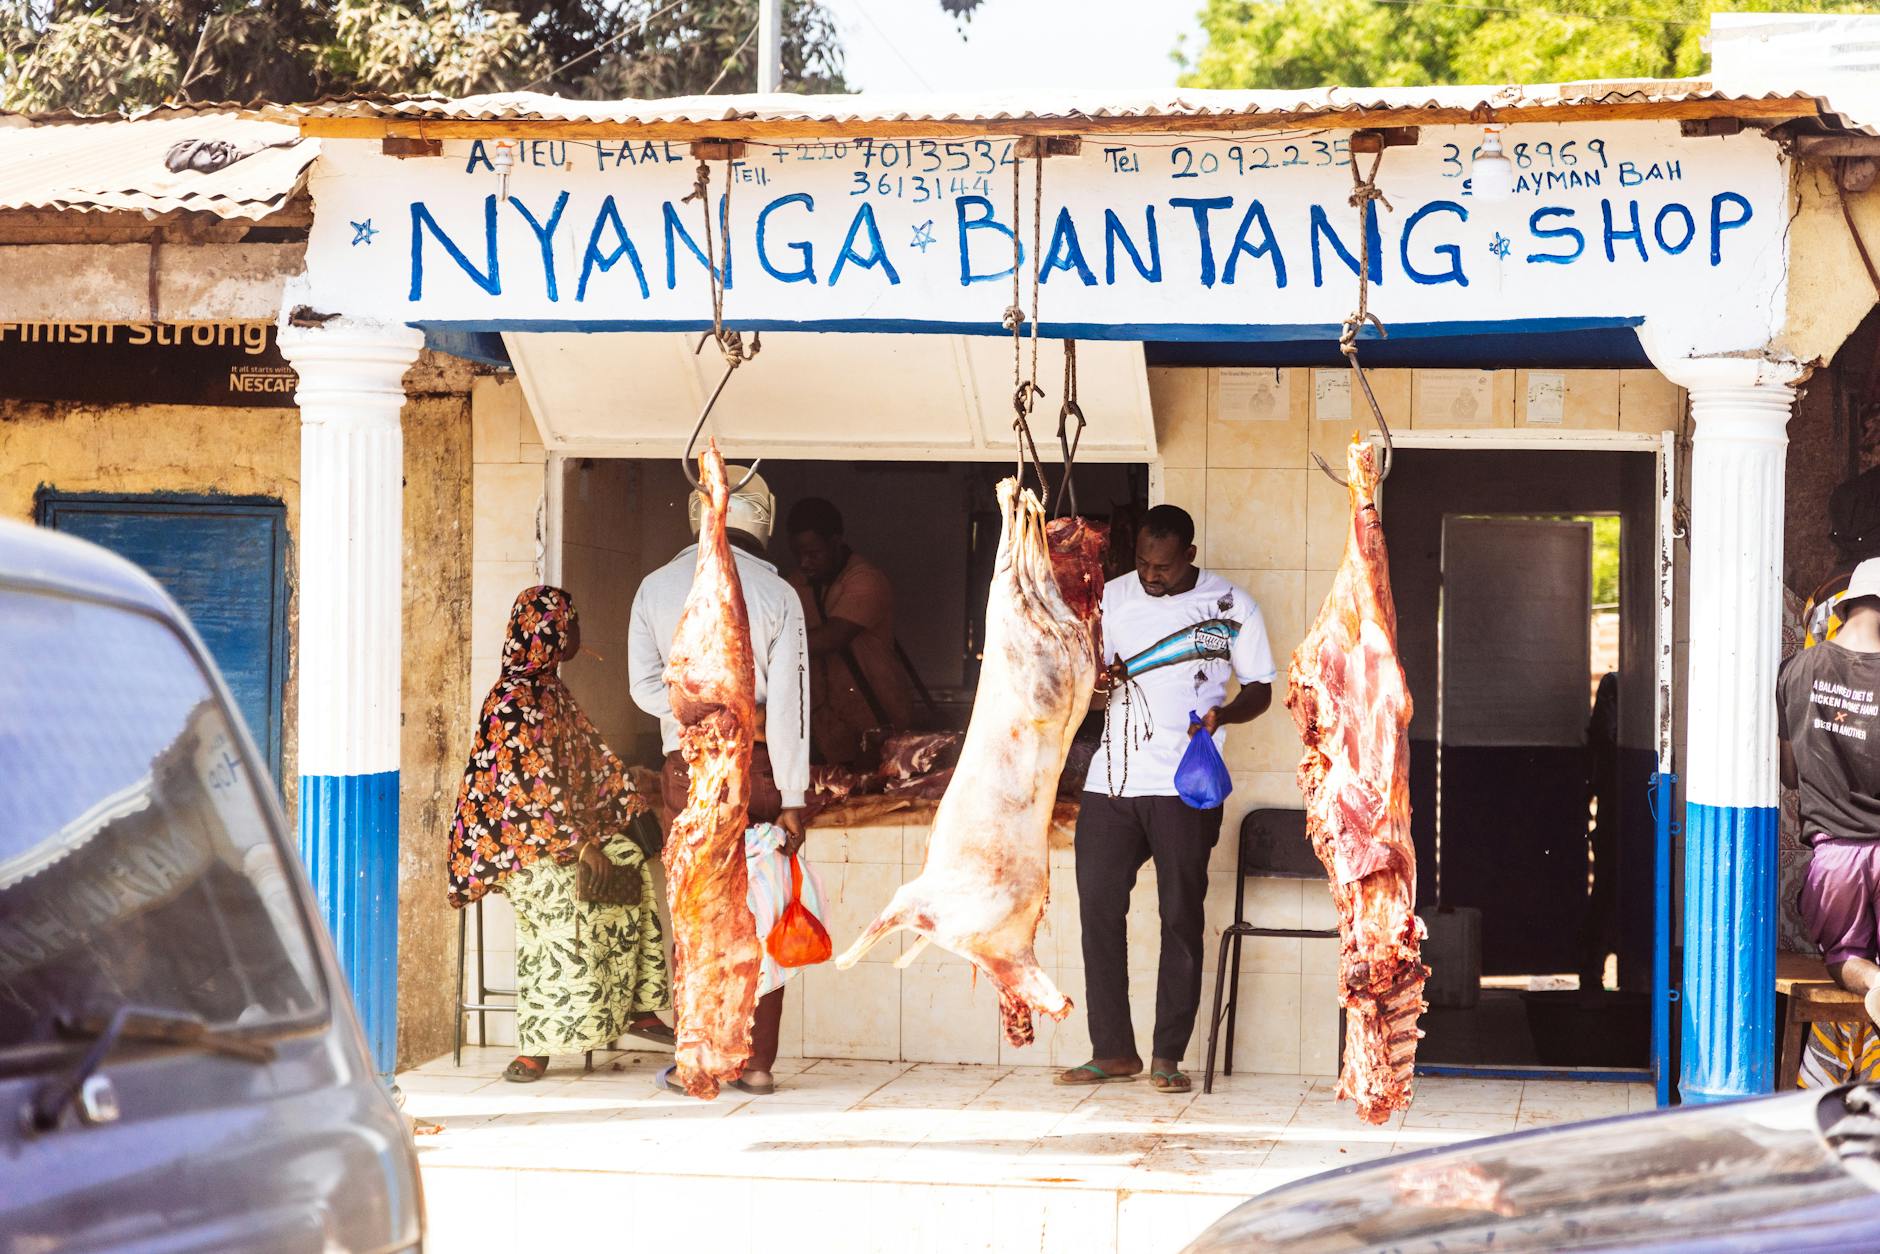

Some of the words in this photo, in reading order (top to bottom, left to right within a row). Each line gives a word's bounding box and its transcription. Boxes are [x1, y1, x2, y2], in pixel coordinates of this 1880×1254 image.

[465, 139, 565, 174] AIEU
[1170, 139, 1352, 179] 2092235
[1442, 138, 1608, 178] 38969
[850, 171, 993, 203] 3613144
[1619, 160, 1682, 187] BAH
[409, 190, 901, 303] NYANGA
[955, 195, 1470, 289] BANTANG
[1527, 191, 1753, 266] SHOP
[128, 323, 267, 354] Strong
[251, 366, 273, 374] starts
[275, 366, 291, 374] with
